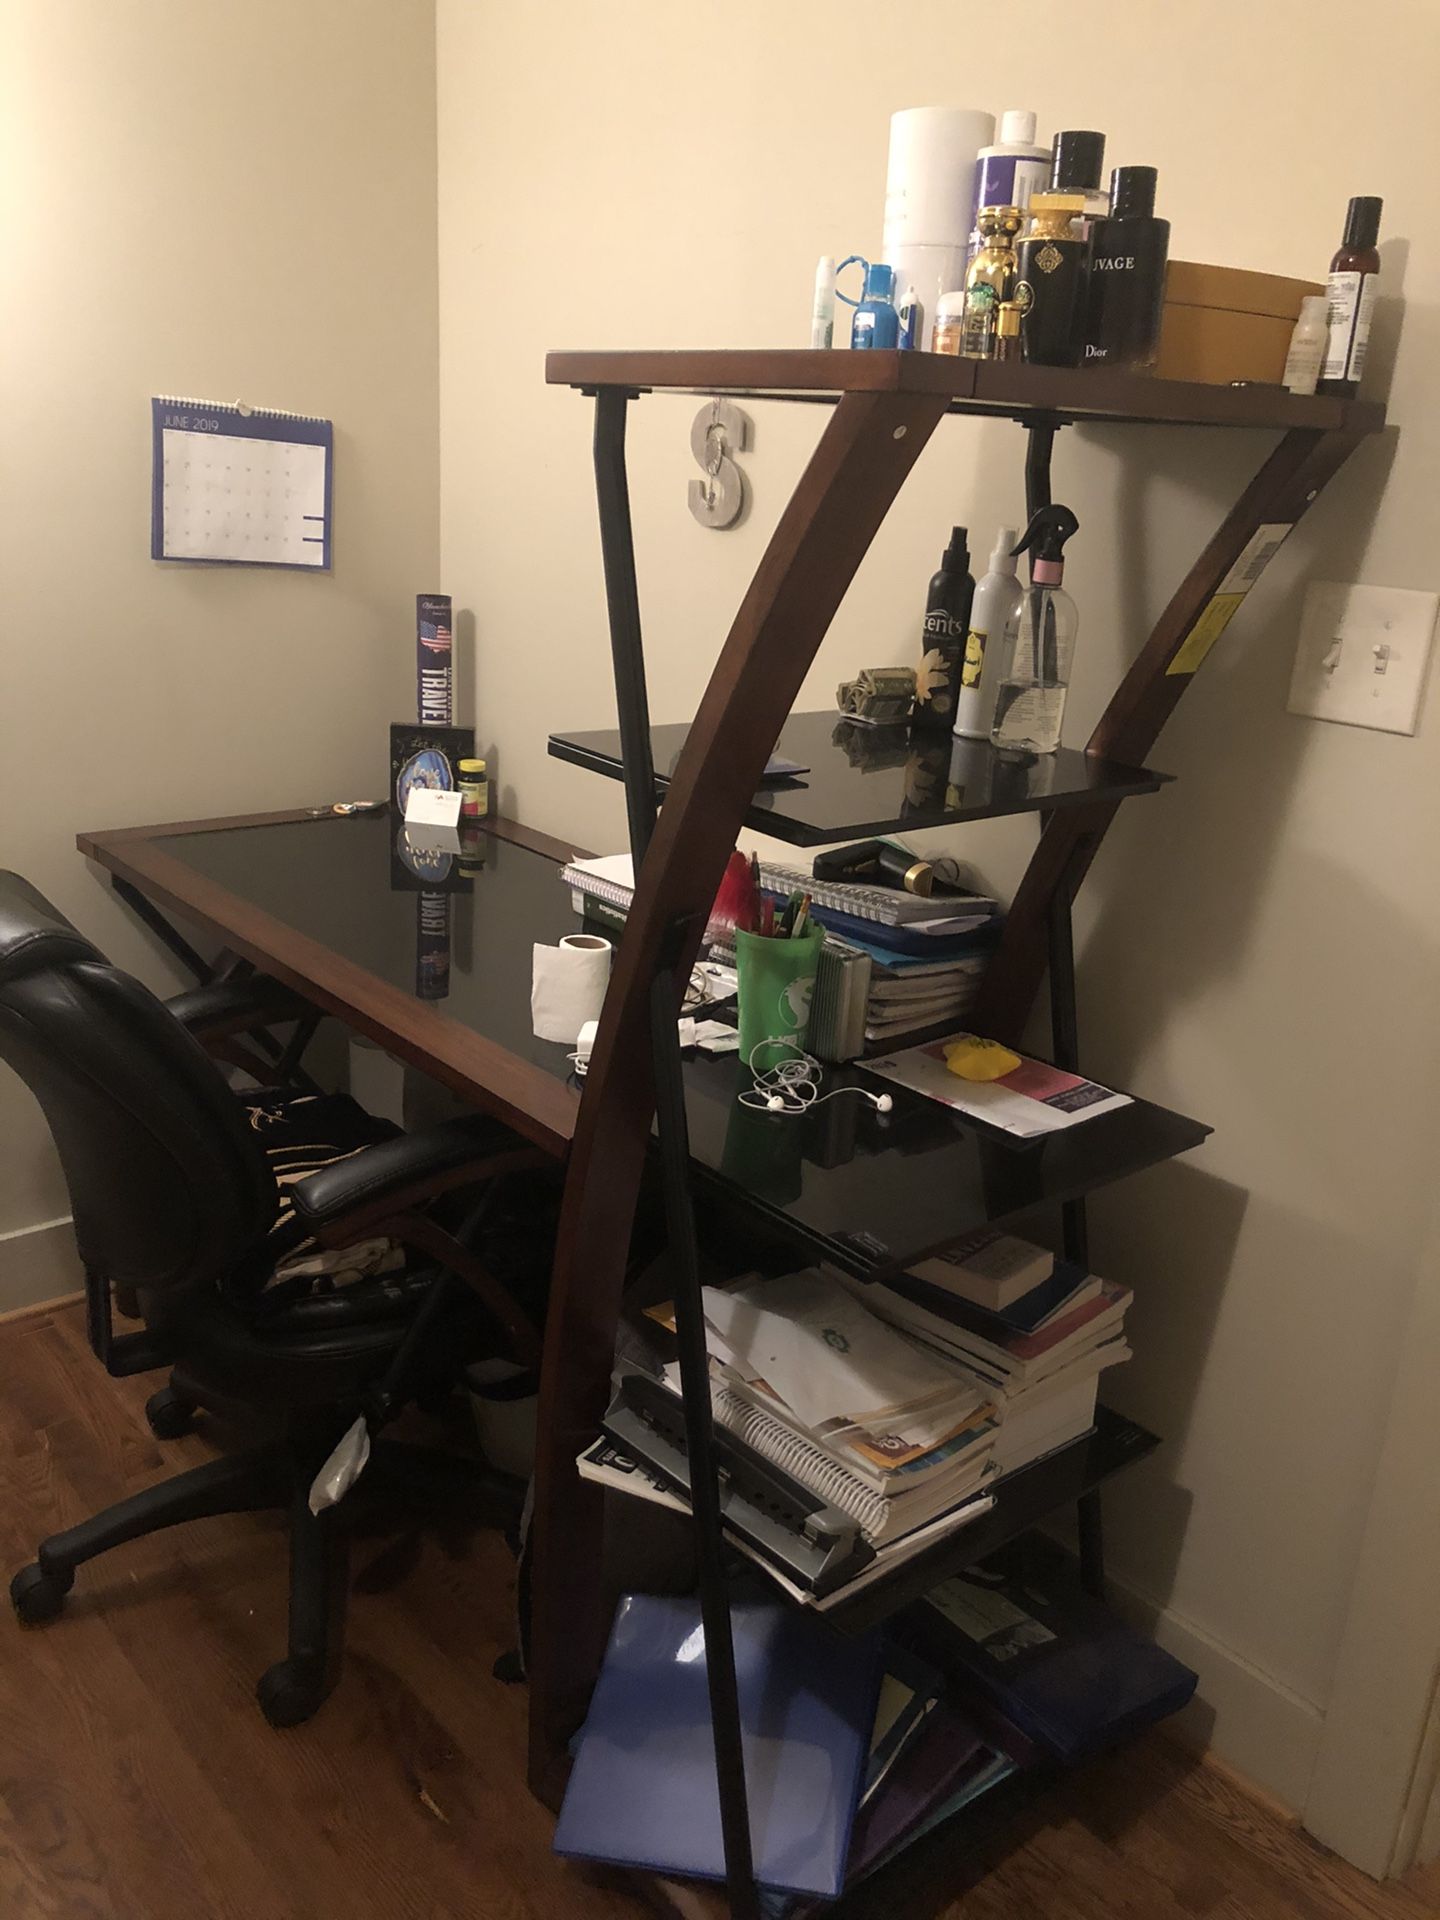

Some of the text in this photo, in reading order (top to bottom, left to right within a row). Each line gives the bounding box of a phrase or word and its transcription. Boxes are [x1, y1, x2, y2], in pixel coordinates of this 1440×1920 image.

[1085, 343, 1109, 358] Dior
[163, 415, 219, 431] JUNE 2019
